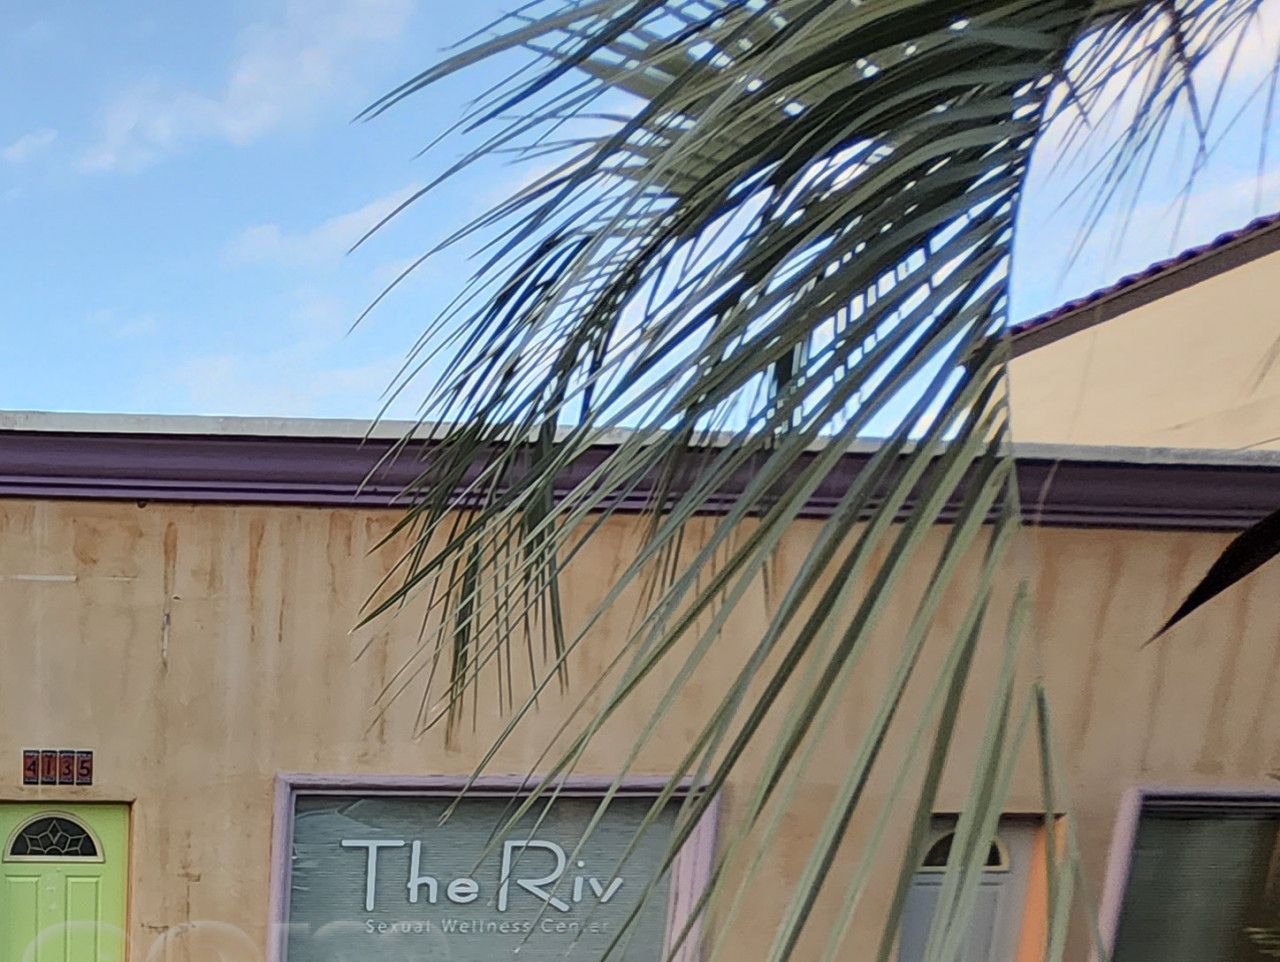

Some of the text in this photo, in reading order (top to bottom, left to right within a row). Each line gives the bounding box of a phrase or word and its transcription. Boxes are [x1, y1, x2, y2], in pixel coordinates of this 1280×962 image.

[24, 755, 91, 781] 4135
[340, 839, 625, 912] The Riv
[365, 918, 432, 934] Sexual
[441, 918, 531, 934] Wellness
